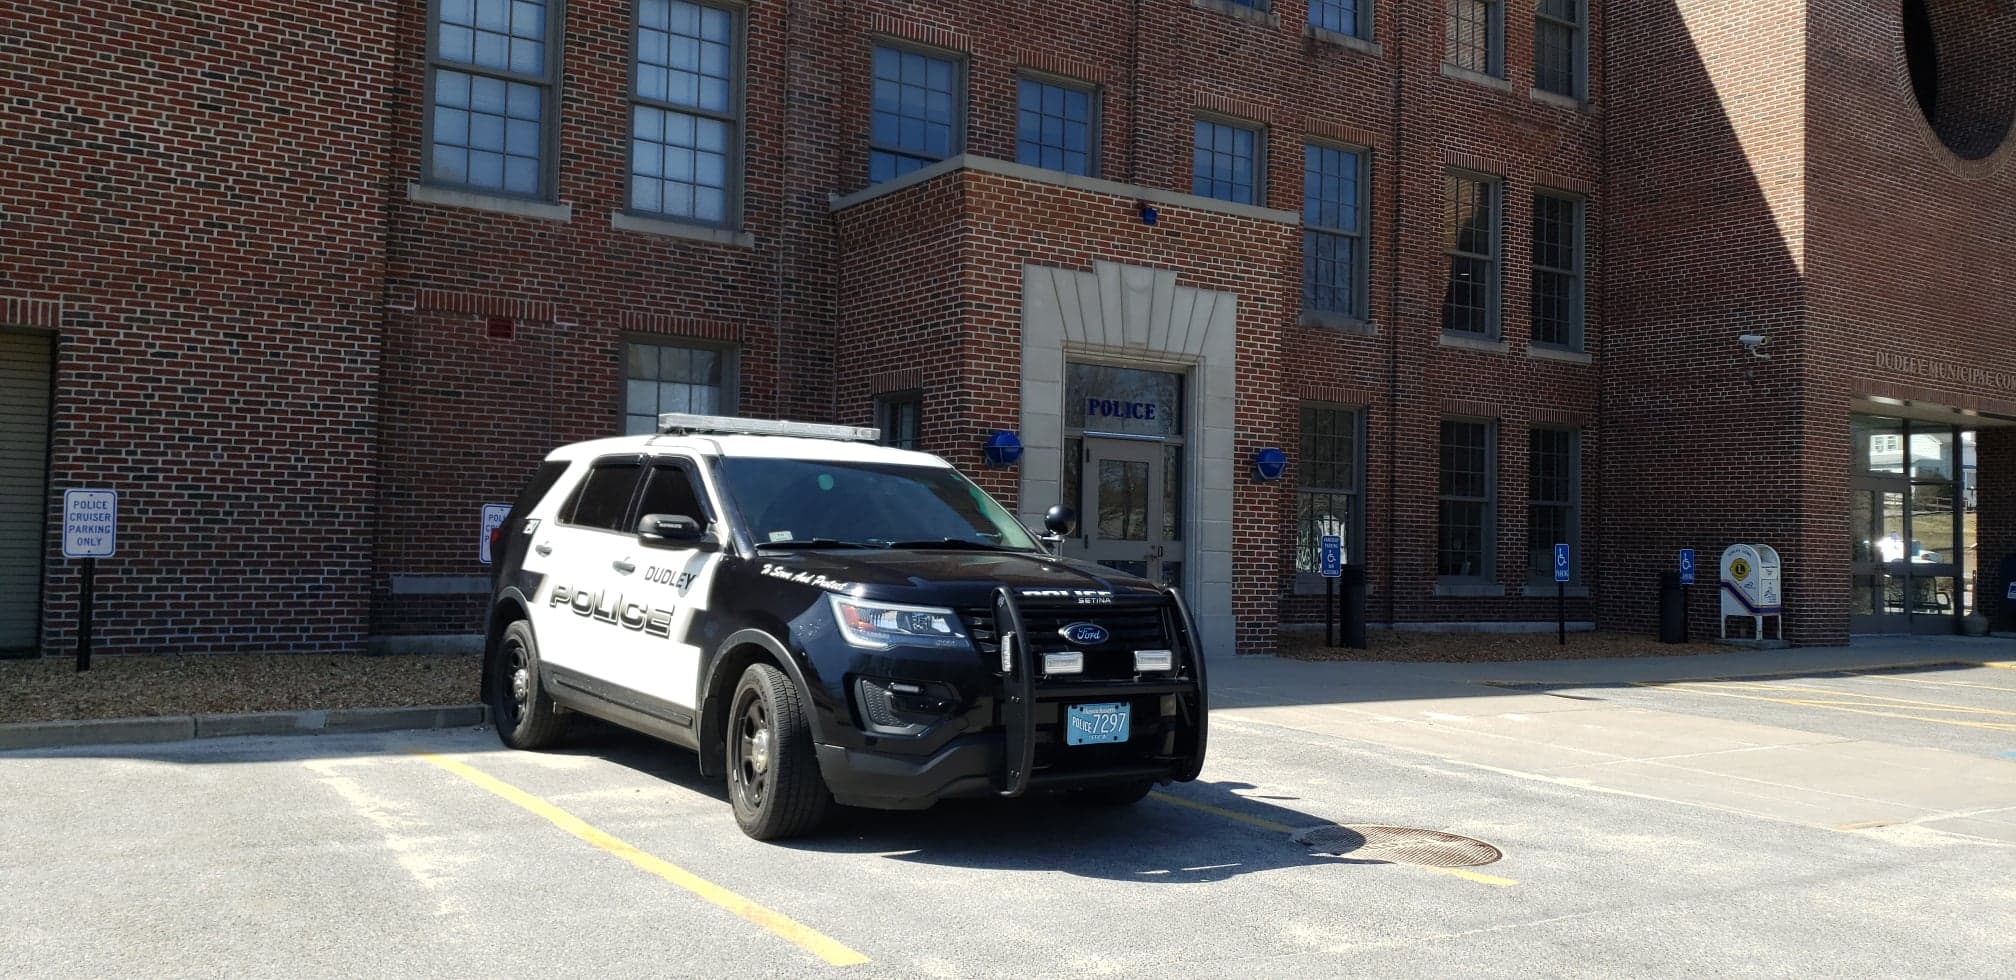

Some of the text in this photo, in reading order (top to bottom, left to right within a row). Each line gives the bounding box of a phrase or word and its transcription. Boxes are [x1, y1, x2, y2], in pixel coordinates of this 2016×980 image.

[1088, 398, 1156, 420] POLICE
[73, 500, 109, 510] POLICE
[69, 512, 111, 522] CRUISER
[68, 524, 111, 534] PARKING
[77, 537, 102, 547] ONLY
[644, 565, 697, 590] DUDLEY
[549, 584, 676, 640] POLICE
[1077, 626, 1101, 641] Ford
[1072, 712, 1126, 734] POLICE 7297
